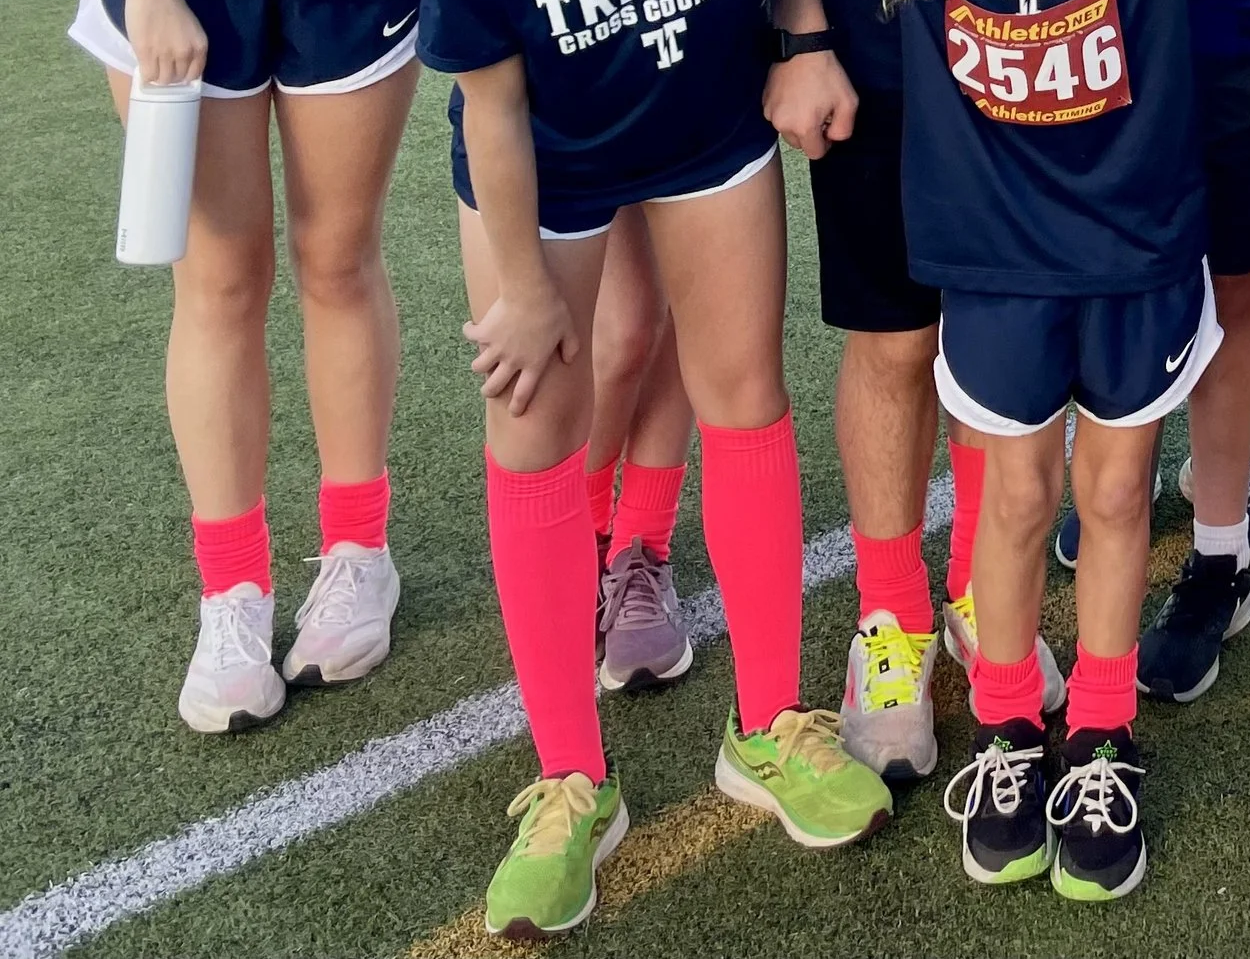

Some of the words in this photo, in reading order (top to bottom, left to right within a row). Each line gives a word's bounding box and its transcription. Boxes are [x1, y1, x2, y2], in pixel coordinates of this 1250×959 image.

[558, 4, 639, 55] CROSS
[948, 25, 1122, 102] 2546
[1058, 103, 1102, 120] TIMING
